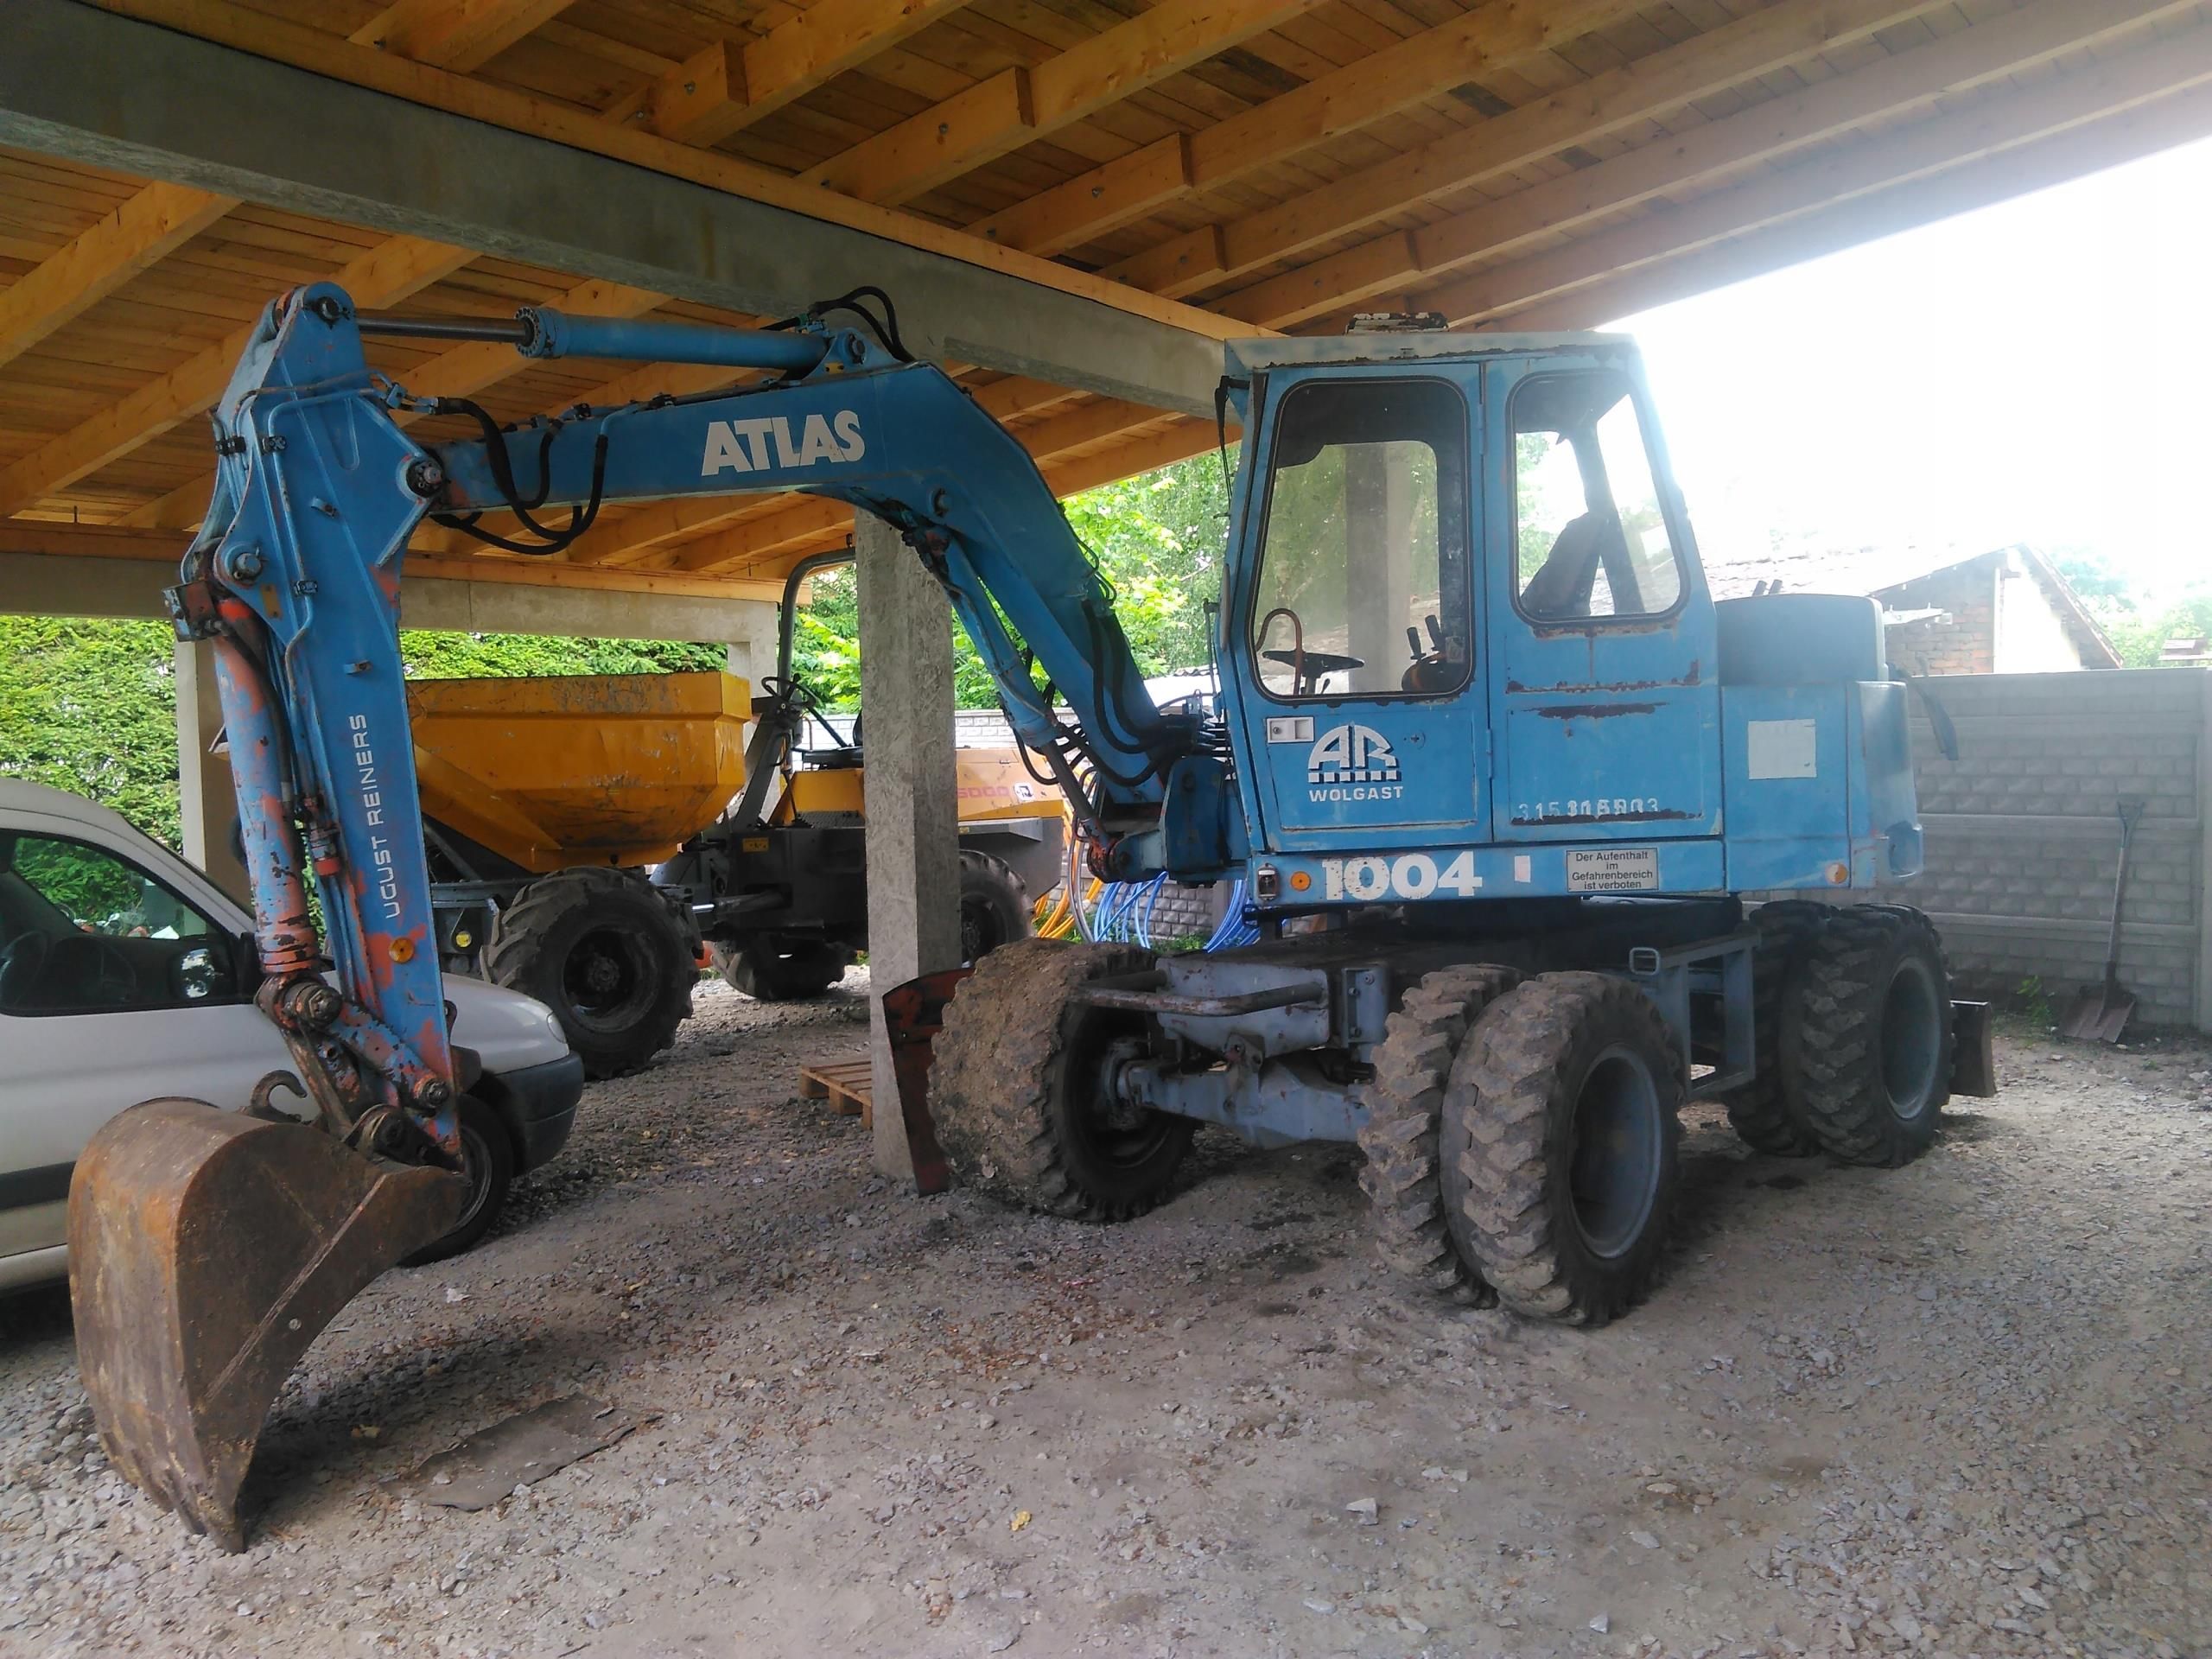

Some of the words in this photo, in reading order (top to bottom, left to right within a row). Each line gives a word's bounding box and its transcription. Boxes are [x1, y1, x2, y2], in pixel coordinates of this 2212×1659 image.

[702, 410, 865, 476] ATLAS
[349, 714, 384, 827] REINERS
[1309, 785, 1404, 803] WOLGAST
[1575, 852, 1593, 861] Der
[1596, 850, 1649, 861] Aufenthalt
[1606, 861, 1618, 870] im
[1322, 851, 1483, 900] 1004
[1572, 869, 1653, 880] Gefahrenbereich
[1584, 880, 1596, 890] ist
[1598, 880, 1642, 889] verboten
